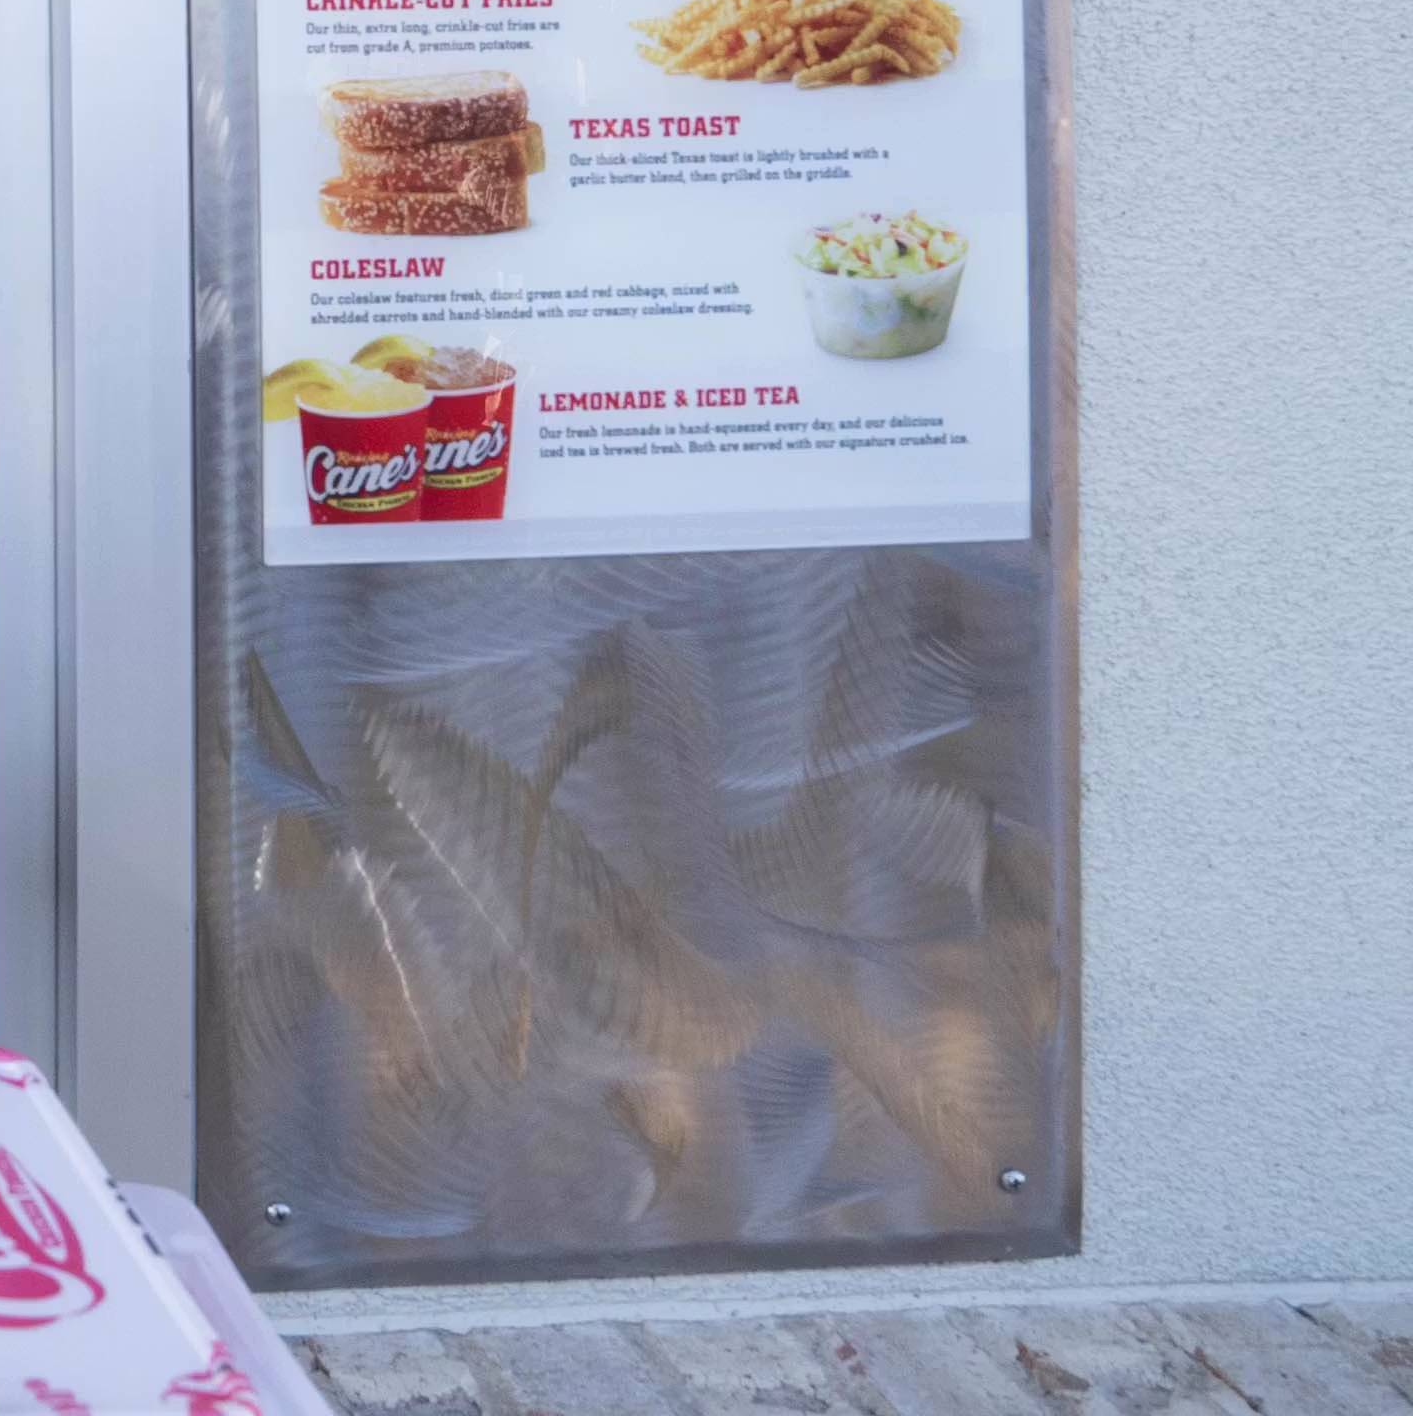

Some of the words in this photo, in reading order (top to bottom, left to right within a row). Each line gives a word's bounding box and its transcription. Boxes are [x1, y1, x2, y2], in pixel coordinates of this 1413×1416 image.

[569, 117, 650, 139] TEXAS
[659, 115, 741, 137] TOAST
[311, 257, 445, 280] COLESLAW
[539, 390, 667, 412] LEMONADE
[673, 389, 689, 409] &
[696, 387, 747, 408] ICED
[755, 386, 799, 407] TEA
[306, 444, 420, 502] Cane's
